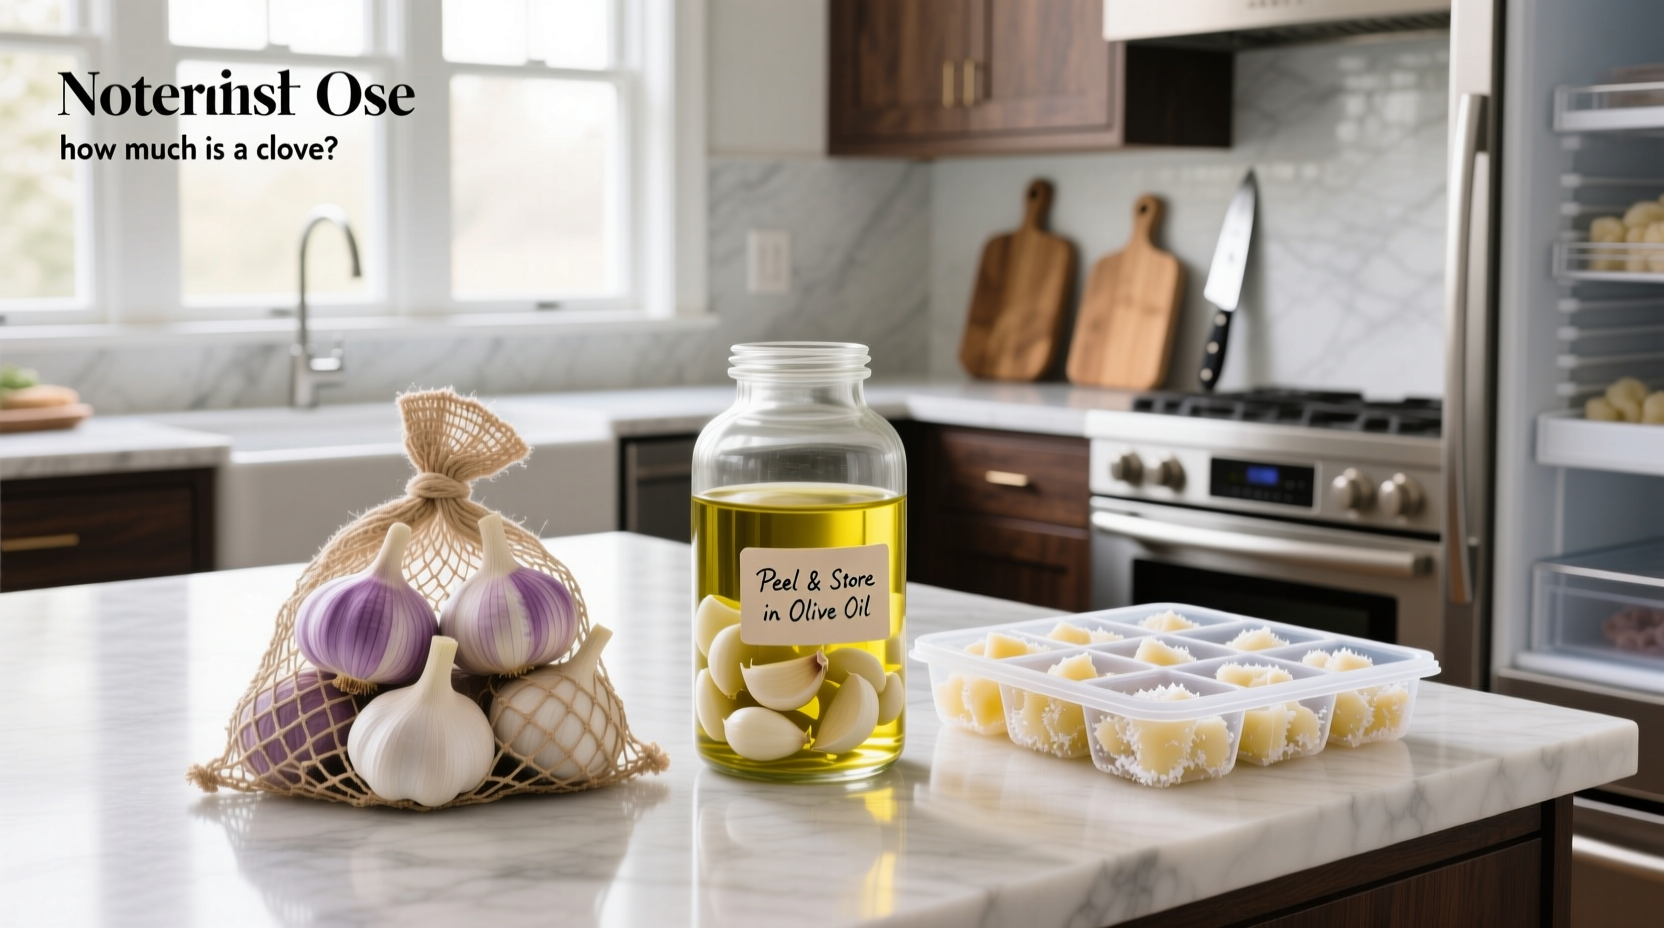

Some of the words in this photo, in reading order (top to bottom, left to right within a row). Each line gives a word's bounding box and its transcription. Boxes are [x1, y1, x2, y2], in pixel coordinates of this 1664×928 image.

[755, 567, 800, 593] Peel
[807, 570, 821, 592] &
[829, 568, 876, 591] Store
[763, 603, 781, 621] in
[789, 598, 837, 622] Olive
[844, 594, 871, 619] Oil
